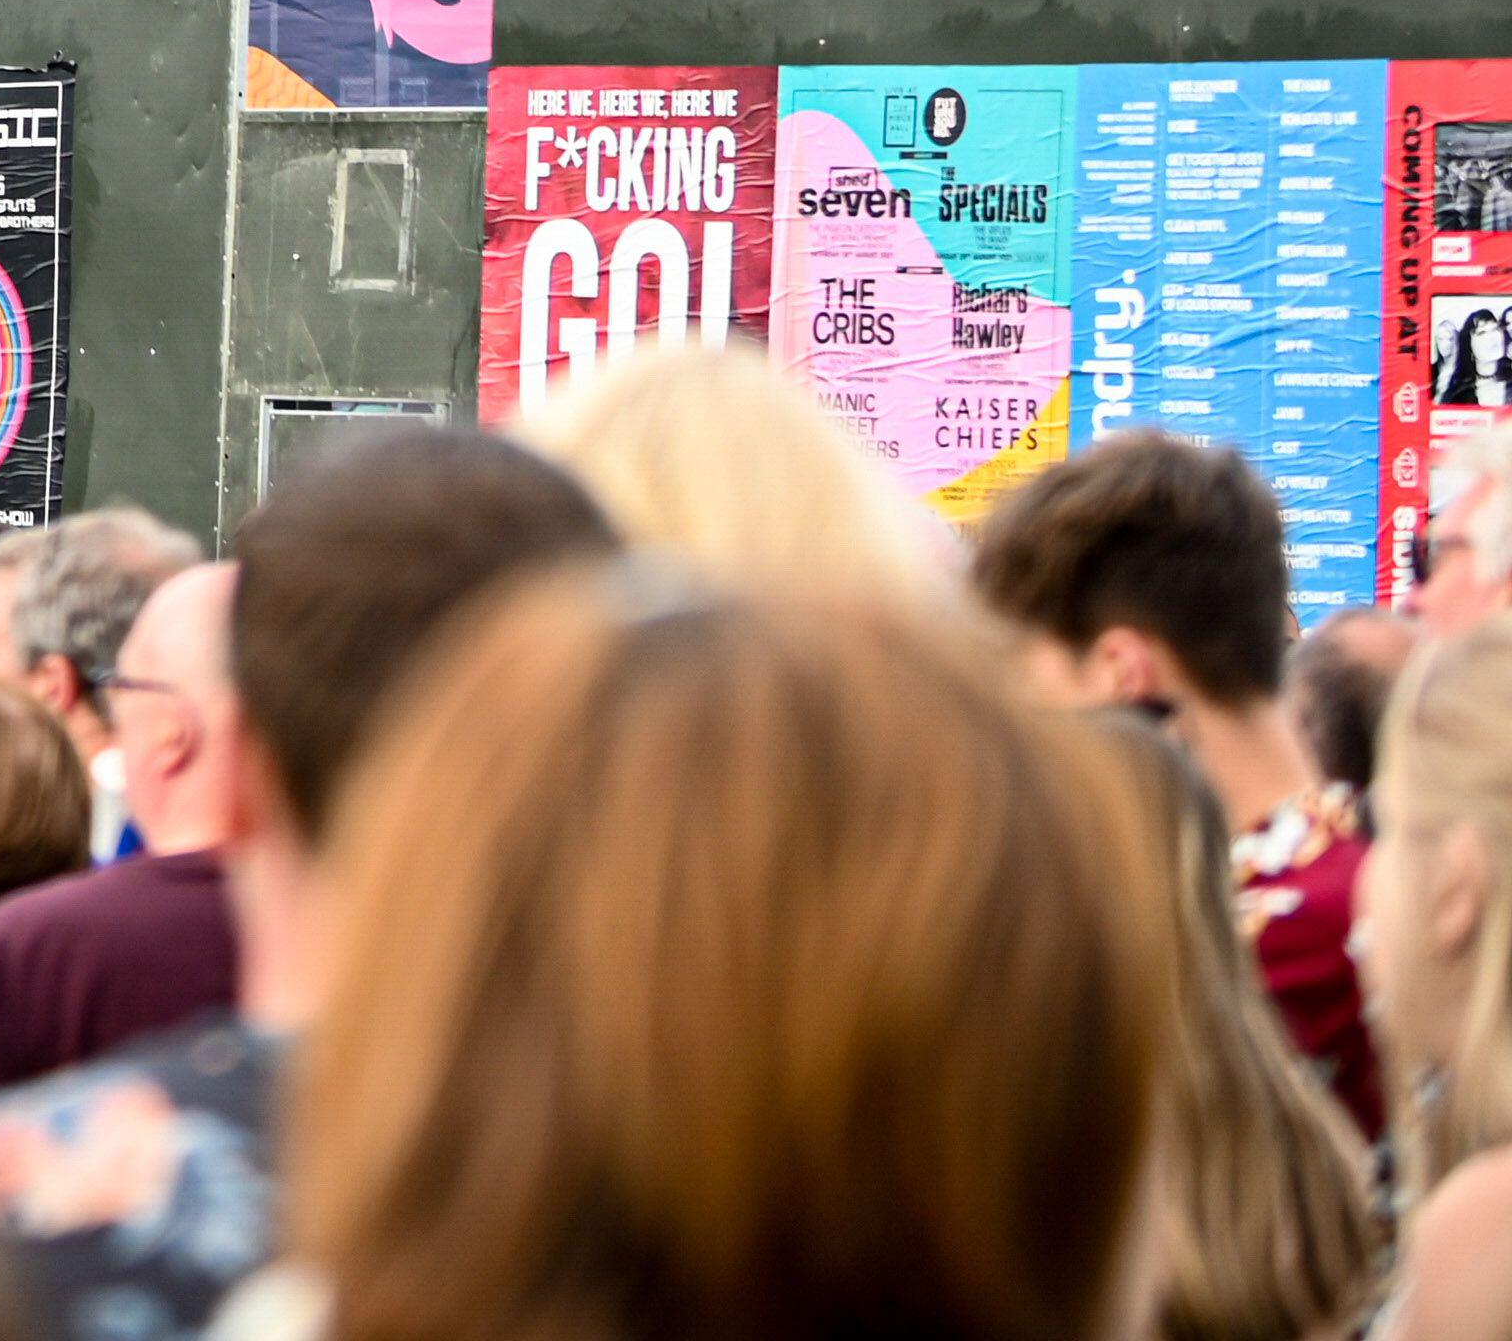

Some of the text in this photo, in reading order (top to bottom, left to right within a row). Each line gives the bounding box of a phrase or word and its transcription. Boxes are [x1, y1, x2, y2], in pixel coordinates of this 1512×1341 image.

[528, 89, 738, 119] HERE WE, HERE WE, HERE WE
[834, 172, 871, 187] shed
[798, 187, 911, 218] seven
[939, 183, 1048, 224] SPECIALS
[0, 216, 55, 228] BROTHERS
[1397, 105, 1422, 361] COMING UP AT
[820, 278, 876, 309] THE
[813, 313, 895, 345] CRIBS
[952, 319, 1025, 353] Hawley
[817, 393, 876, 412] MANIC
[935, 397, 1038, 421] KAISER
[935, 426, 1038, 450] CHIEFS
